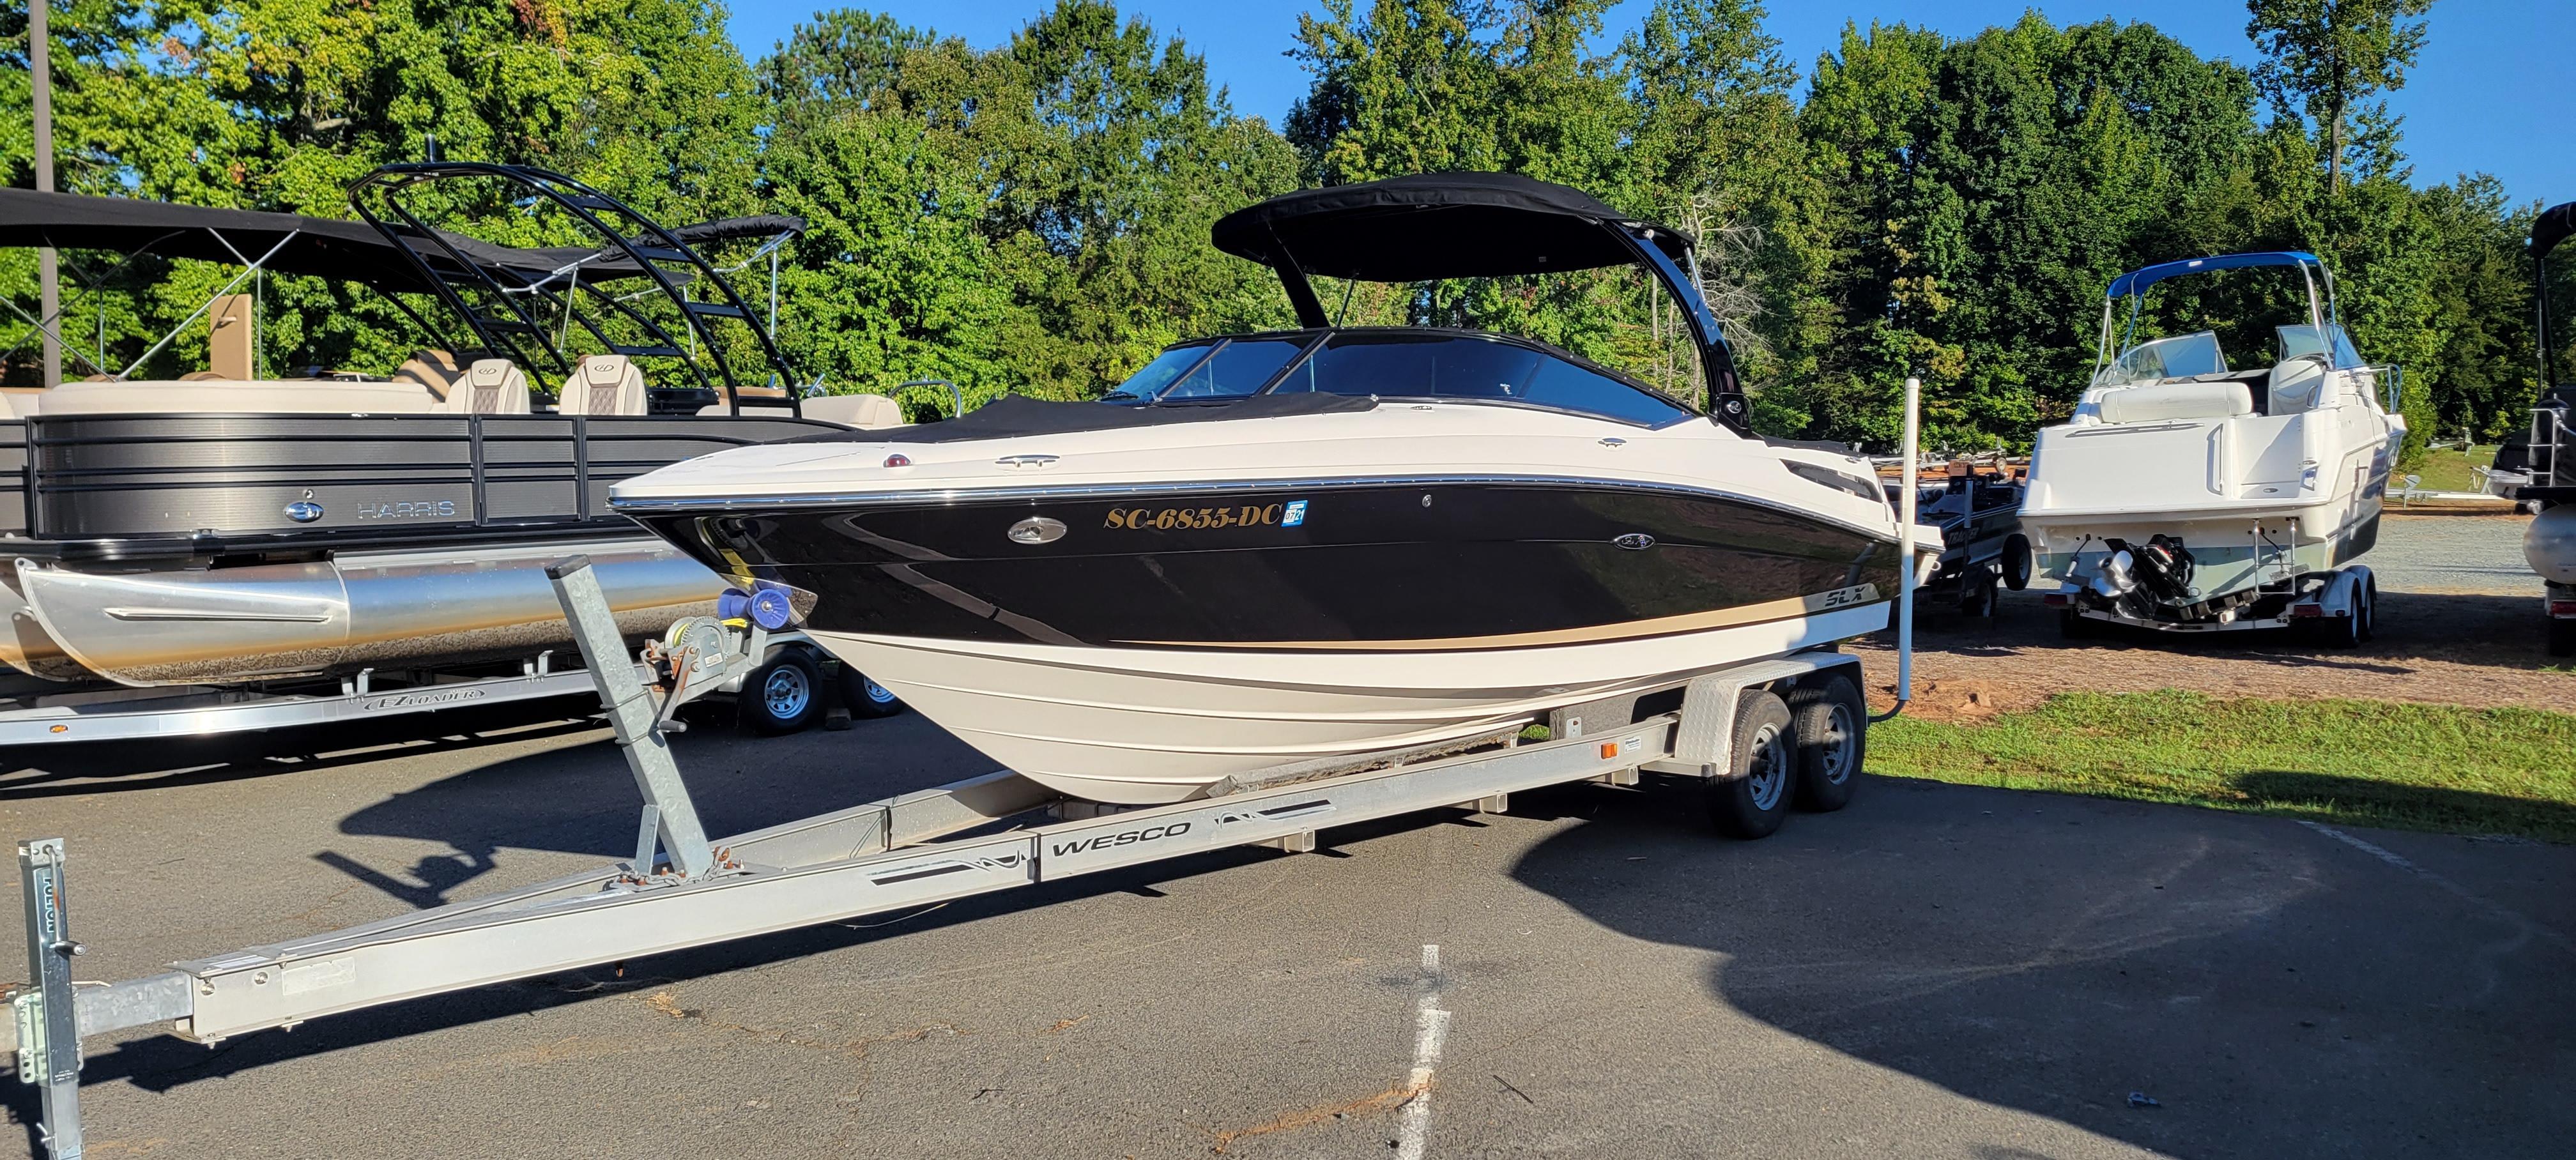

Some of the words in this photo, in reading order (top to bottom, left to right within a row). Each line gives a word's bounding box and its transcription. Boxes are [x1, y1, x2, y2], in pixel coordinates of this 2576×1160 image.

[357, 500, 456, 519] HARRIS
[1103, 503, 1283, 530] SC-6855-DC
[1947, 526, 1979, 545] TRACER
[1825, 586, 1866, 607] SLX
[1053, 822, 1191, 857] WESCO
